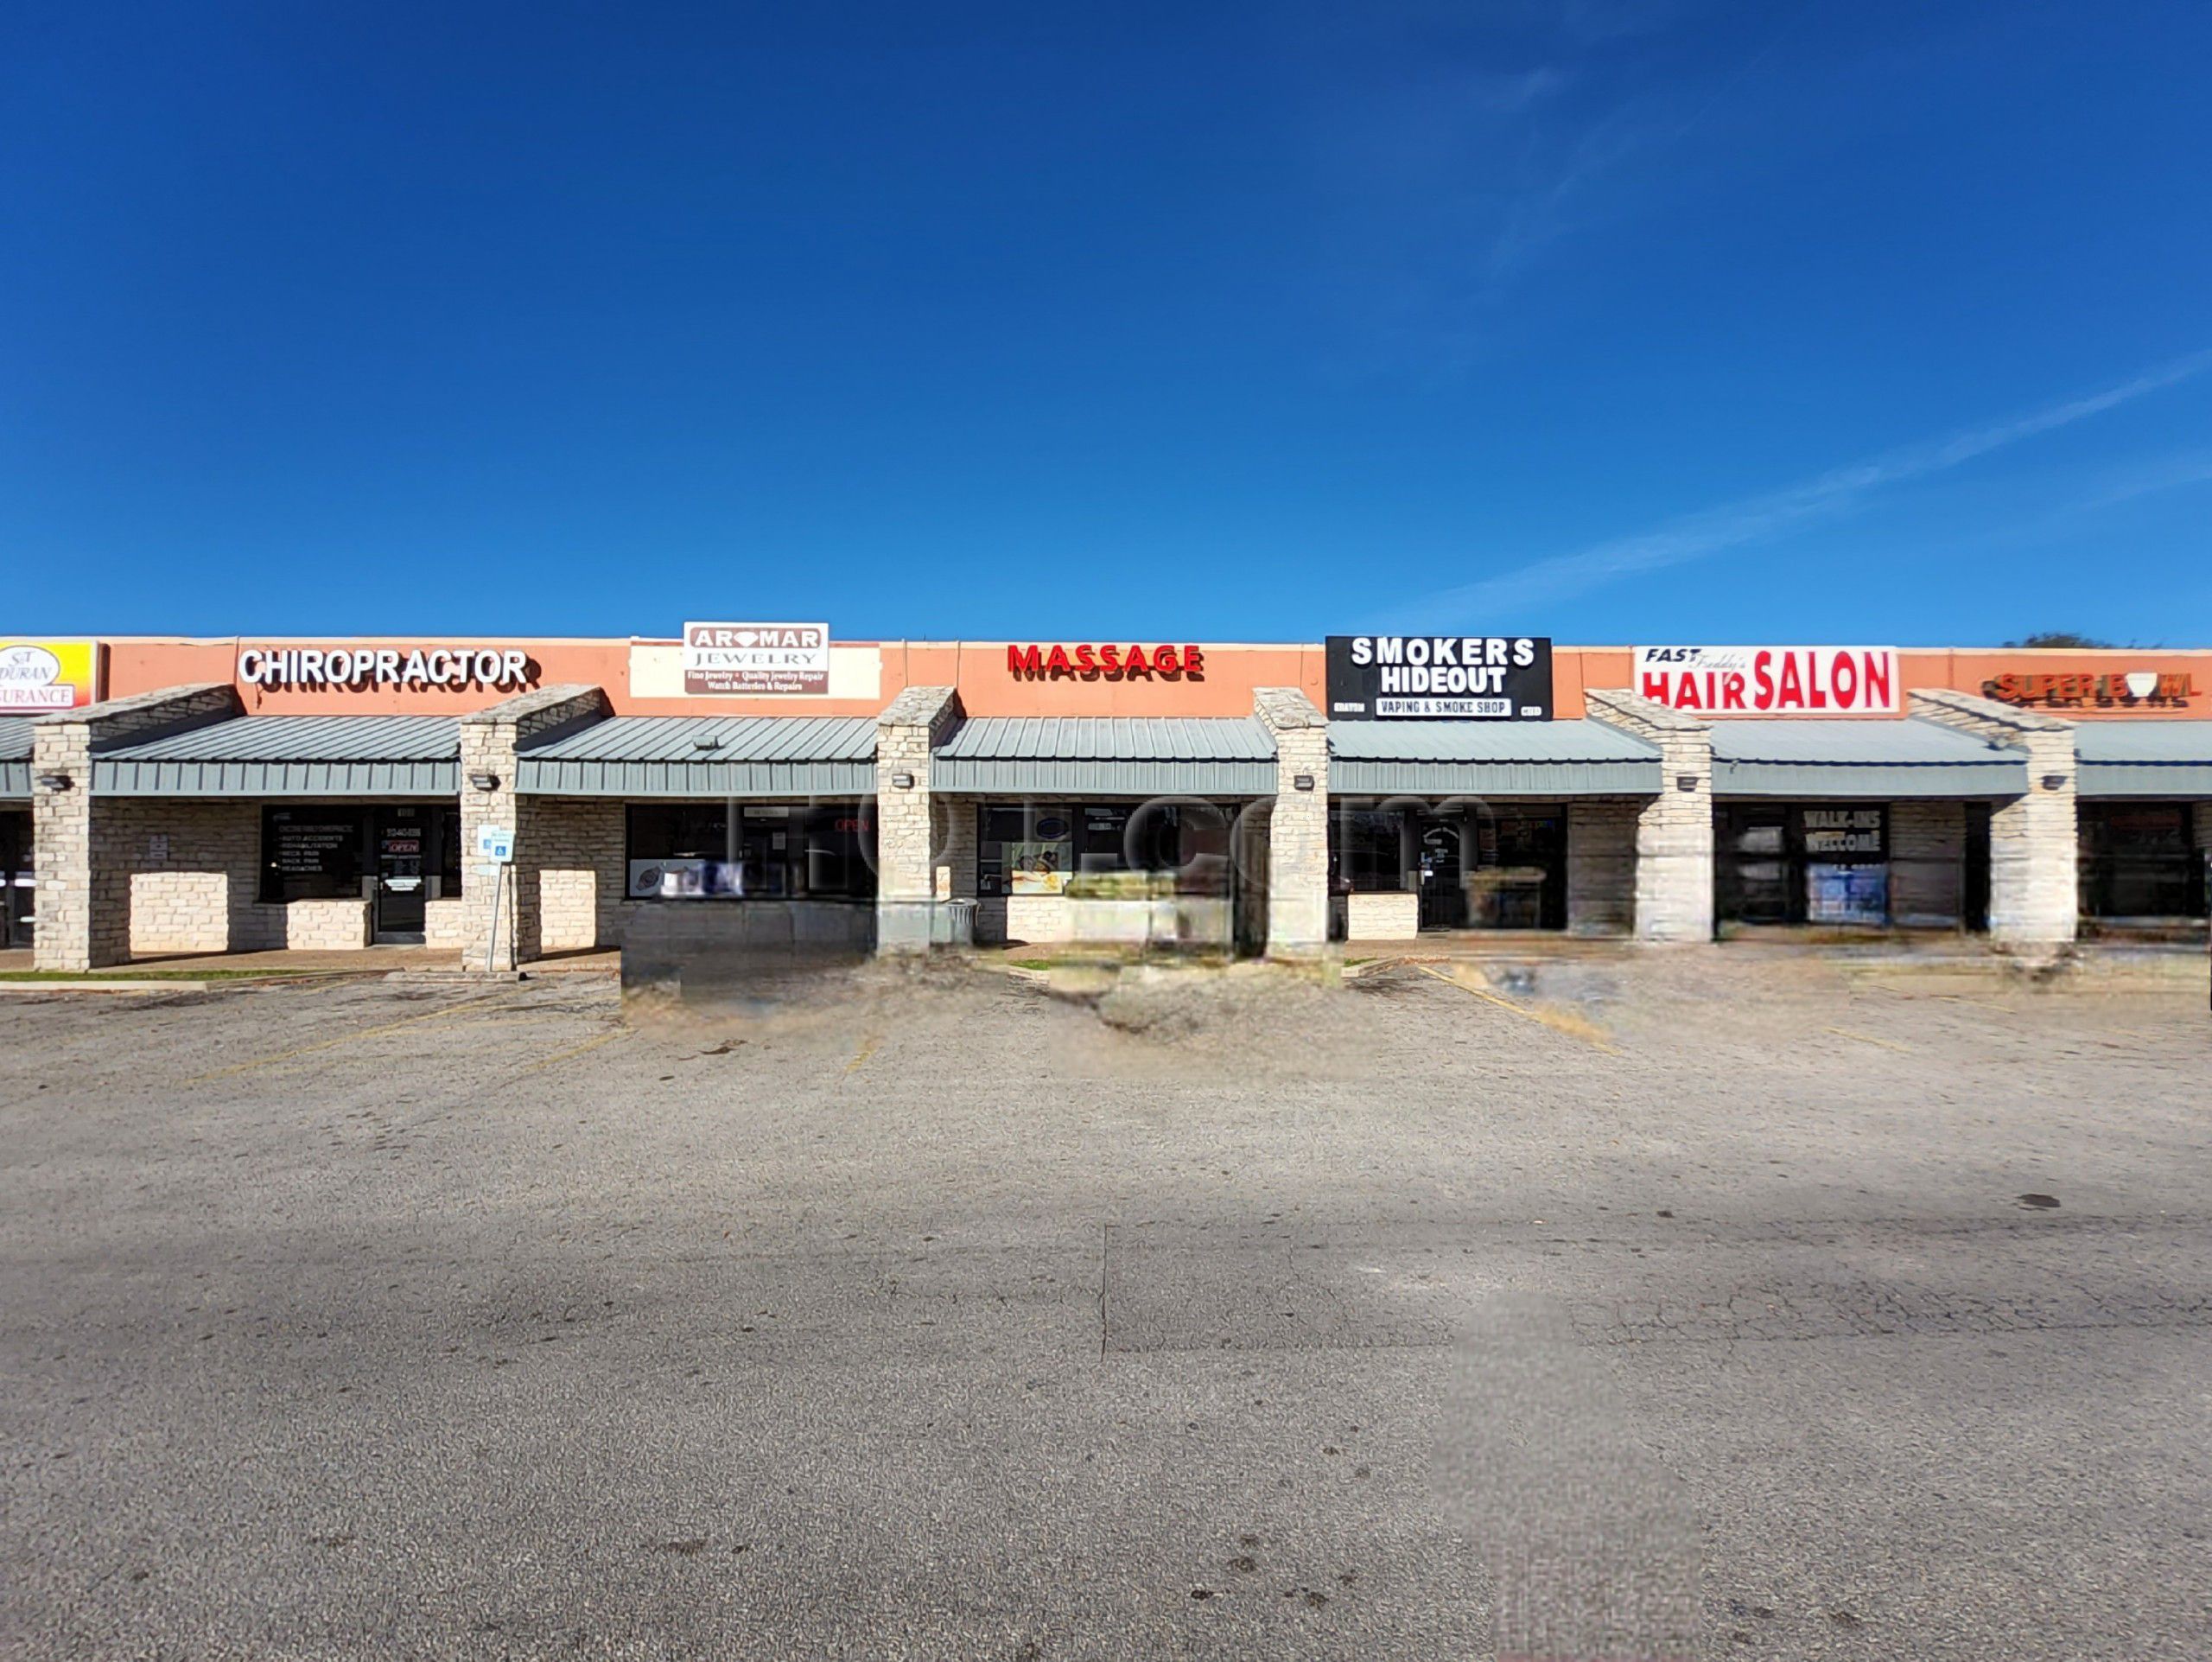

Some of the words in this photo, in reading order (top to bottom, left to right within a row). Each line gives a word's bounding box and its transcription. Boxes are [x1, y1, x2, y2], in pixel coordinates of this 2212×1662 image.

[1007, 645, 1201, 672] MASSAGE
[1351, 637, 1534, 666] SMOKERS
[1645, 649, 1701, 662] FAST
[238, 650, 527, 684] CHIROPRACTOR
[696, 653, 817, 666] JEWELRY
[705, 672, 733, 681] Jewelry
[741, 672, 769, 681] Quality
[771, 672, 798, 681] Jewelry
[799, 672, 823, 681] Repair
[1381, 666, 1506, 693] HIDEOUT
[1643, 672, 1747, 710] HAIR
[1754, 651, 1890, 710] SALON
[774, 682, 803, 692] Repairs
[1995, 673, 2095, 698] SUPER
[0, 689, 69, 703] URANCE
[1381, 701, 1420, 713] VAPING
[1424, 702, 1431, 713] &
[1435, 701, 1474, 714] SMOKE
[1477, 702, 1506, 714] SHOP
[835, 819, 869, 831] OPEN
[1803, 811, 1880, 828] WALK-INS
